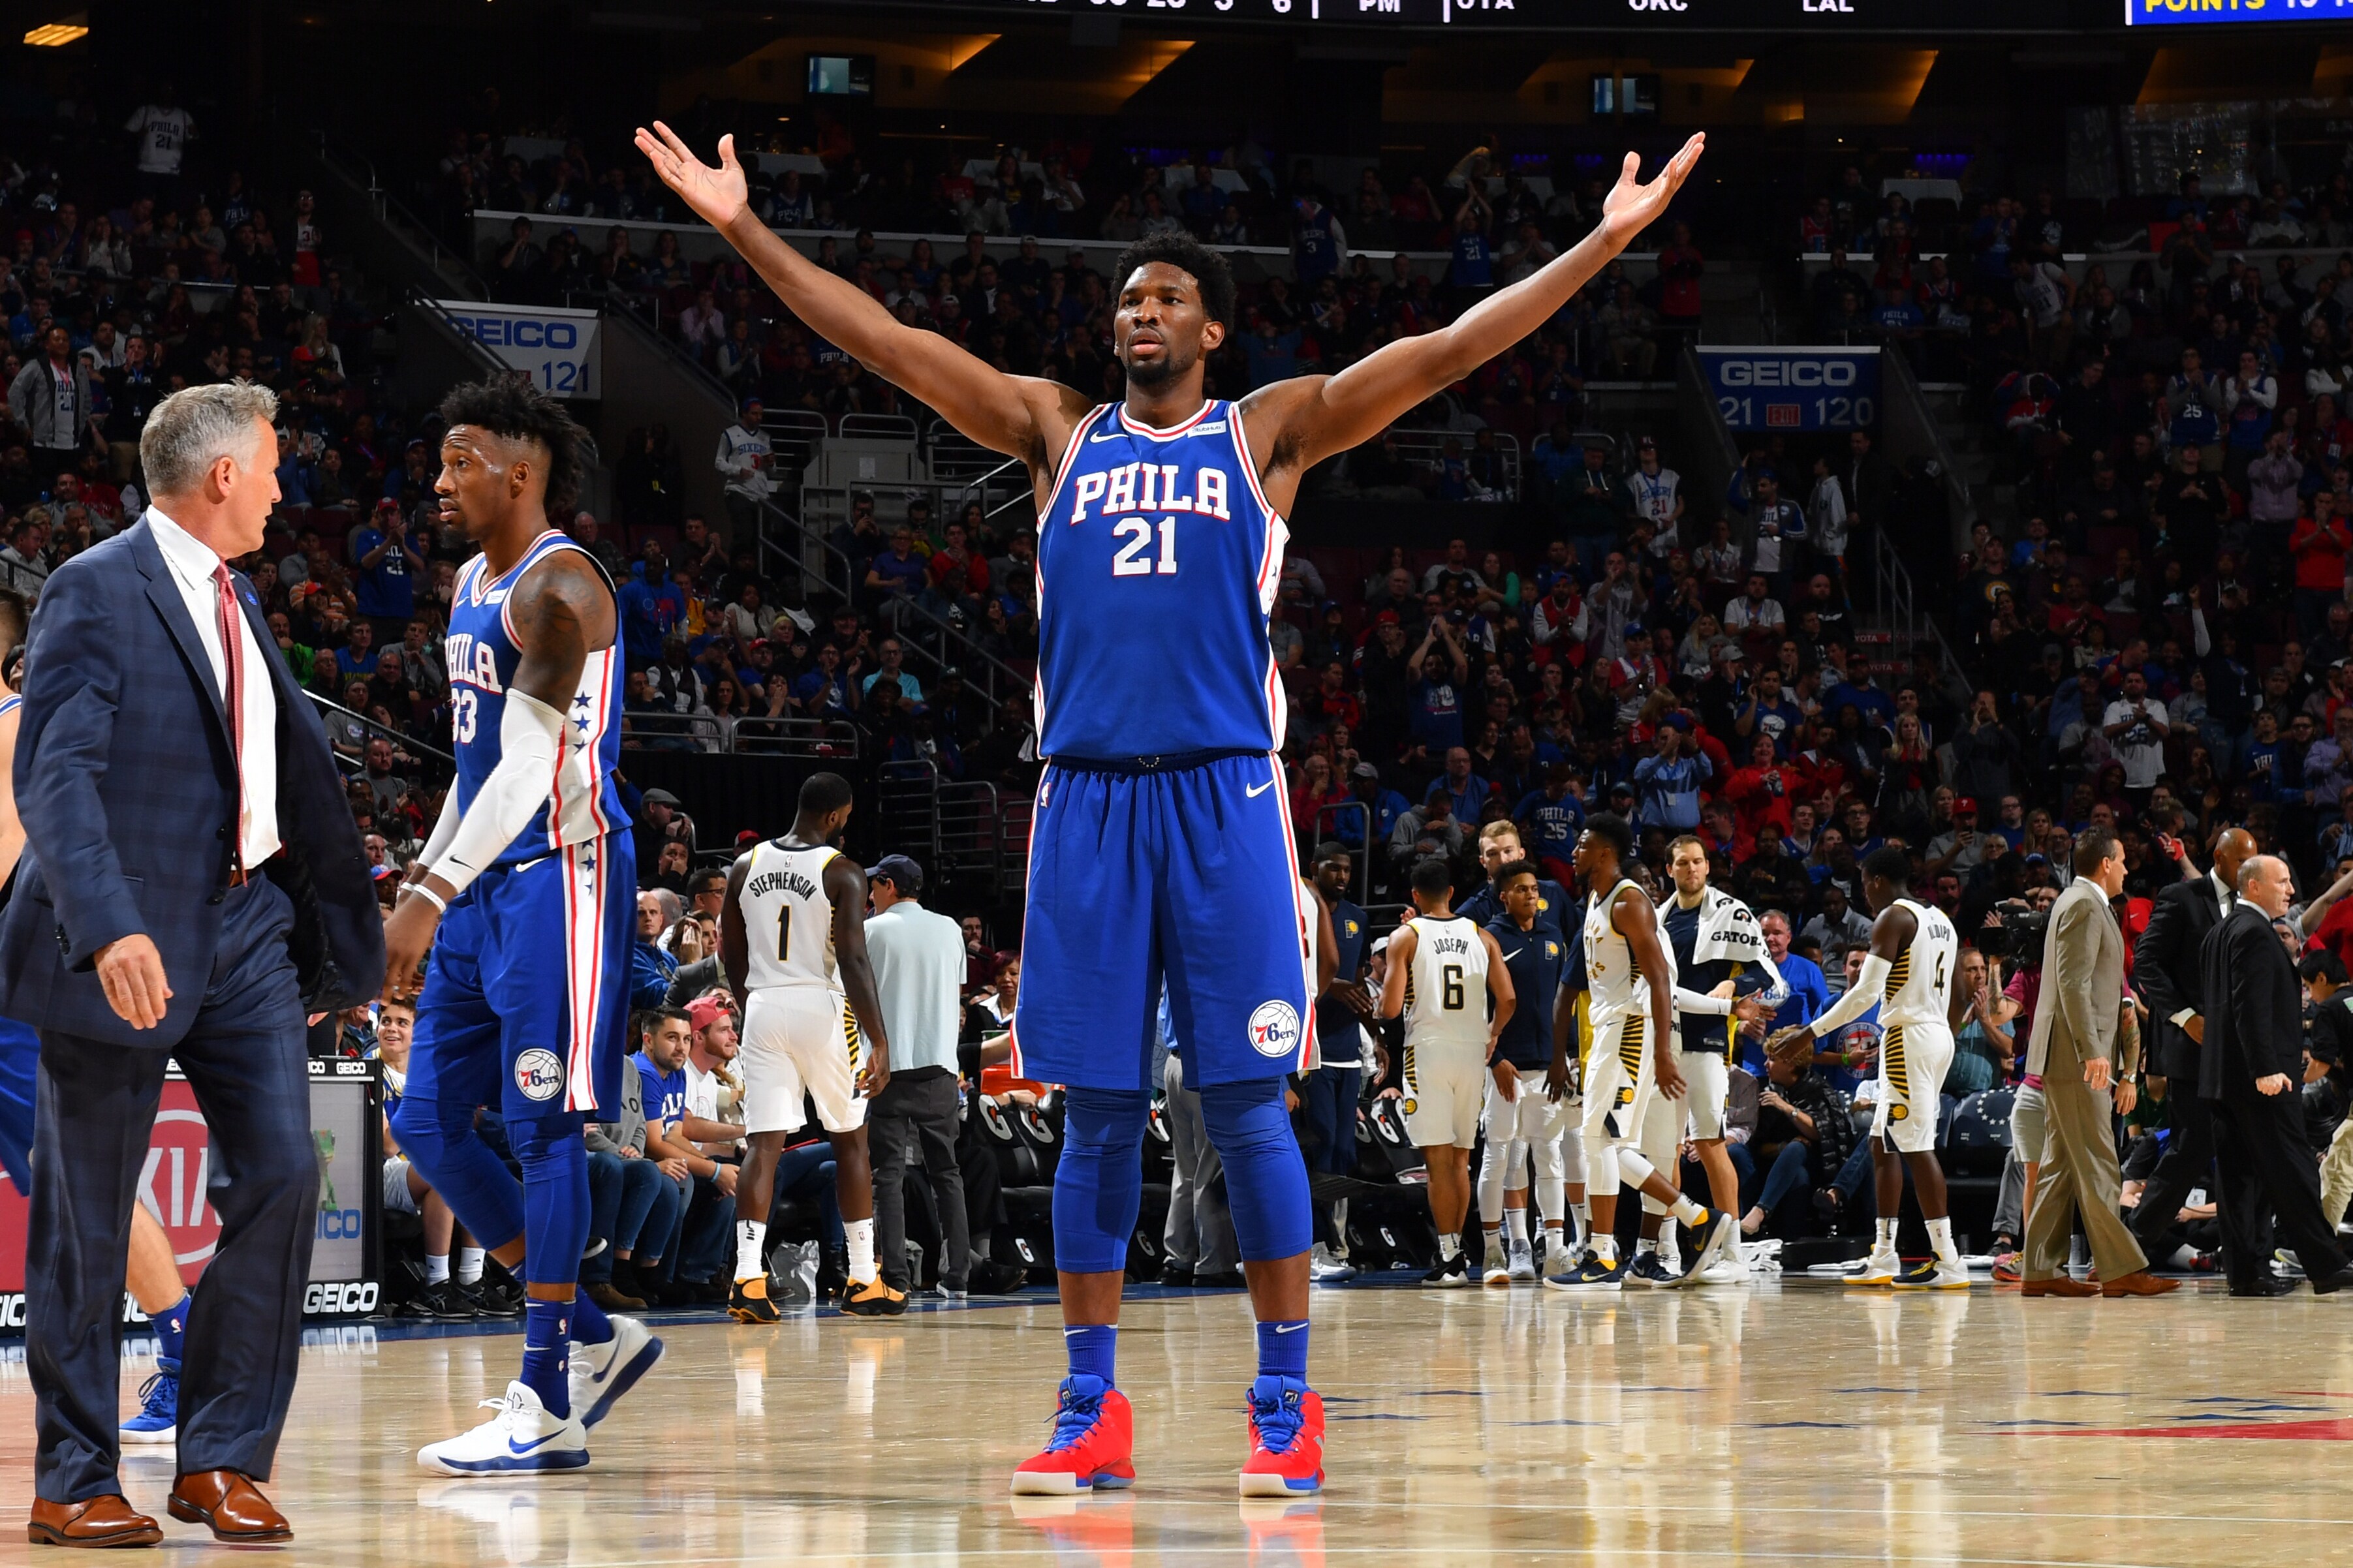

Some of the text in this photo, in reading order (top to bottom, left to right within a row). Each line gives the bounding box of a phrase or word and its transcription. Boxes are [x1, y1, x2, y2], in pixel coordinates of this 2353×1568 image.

[542, 360, 589, 392] 121
[1720, 360, 1857, 387] GEICO
[1815, 396, 1875, 425] 120
[1070, 461, 1231, 526] PHILA
[1112, 515, 1177, 577] 21
[1854, 634, 1878, 643] YOTA
[445, 633, 503, 696] HILA
[1537, 807, 1576, 823] PHILA
[1544, 822, 1568, 840] 25
[749, 871, 817, 901] STEPHENSON
[777, 904, 791, 962] 1
[1433, 938, 1469, 956] JOSEPH
[1442, 963, 1465, 1011] 6
[1933, 950, 1946, 998] 4
[1254, 1022, 1296, 1045] 76ers
[336, 1062, 366, 1075] GEICO
[520, 1068, 559, 1088] 76ers
[302, 1282, 379, 1314] GEICO
